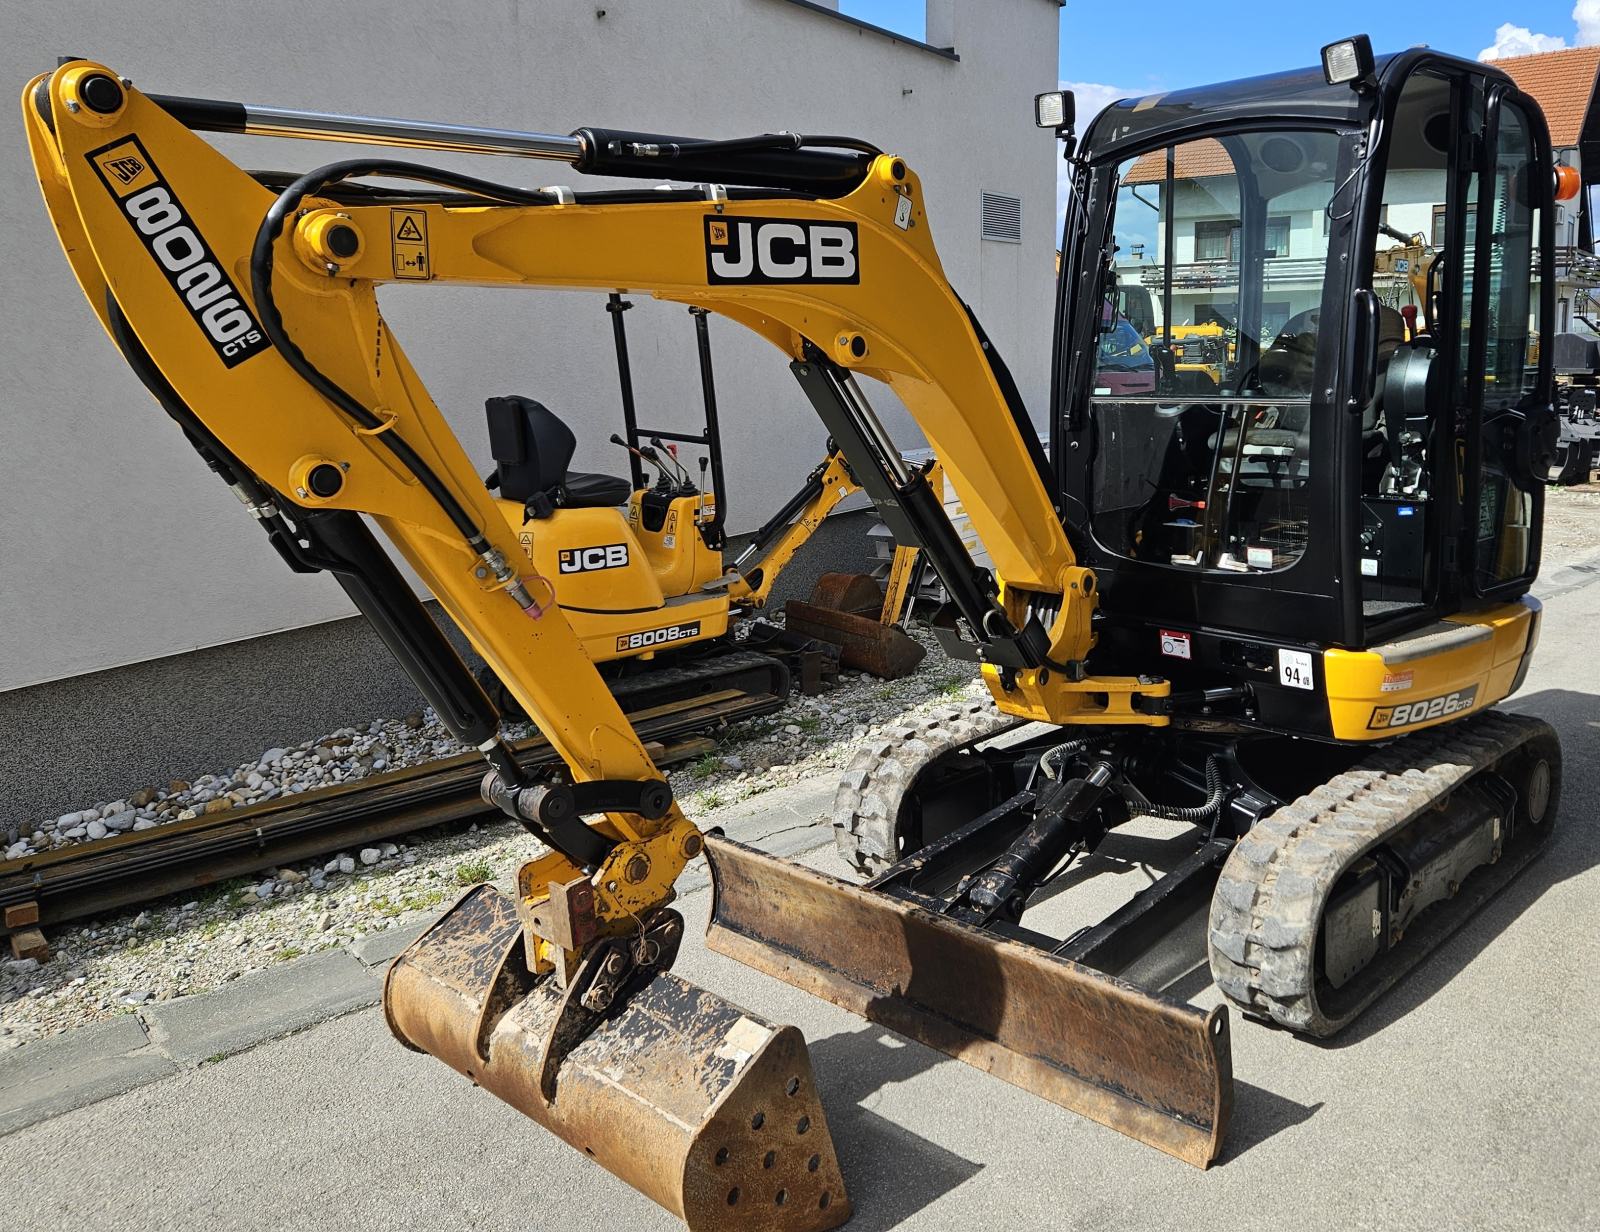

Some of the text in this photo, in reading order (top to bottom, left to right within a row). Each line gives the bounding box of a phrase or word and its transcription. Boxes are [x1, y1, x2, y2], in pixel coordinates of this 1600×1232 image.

[111, 158, 143, 181] JCB
[711, 222, 856, 278] JCB
[561, 545, 628, 572] JCB
[1285, 666, 1300, 684] 94
